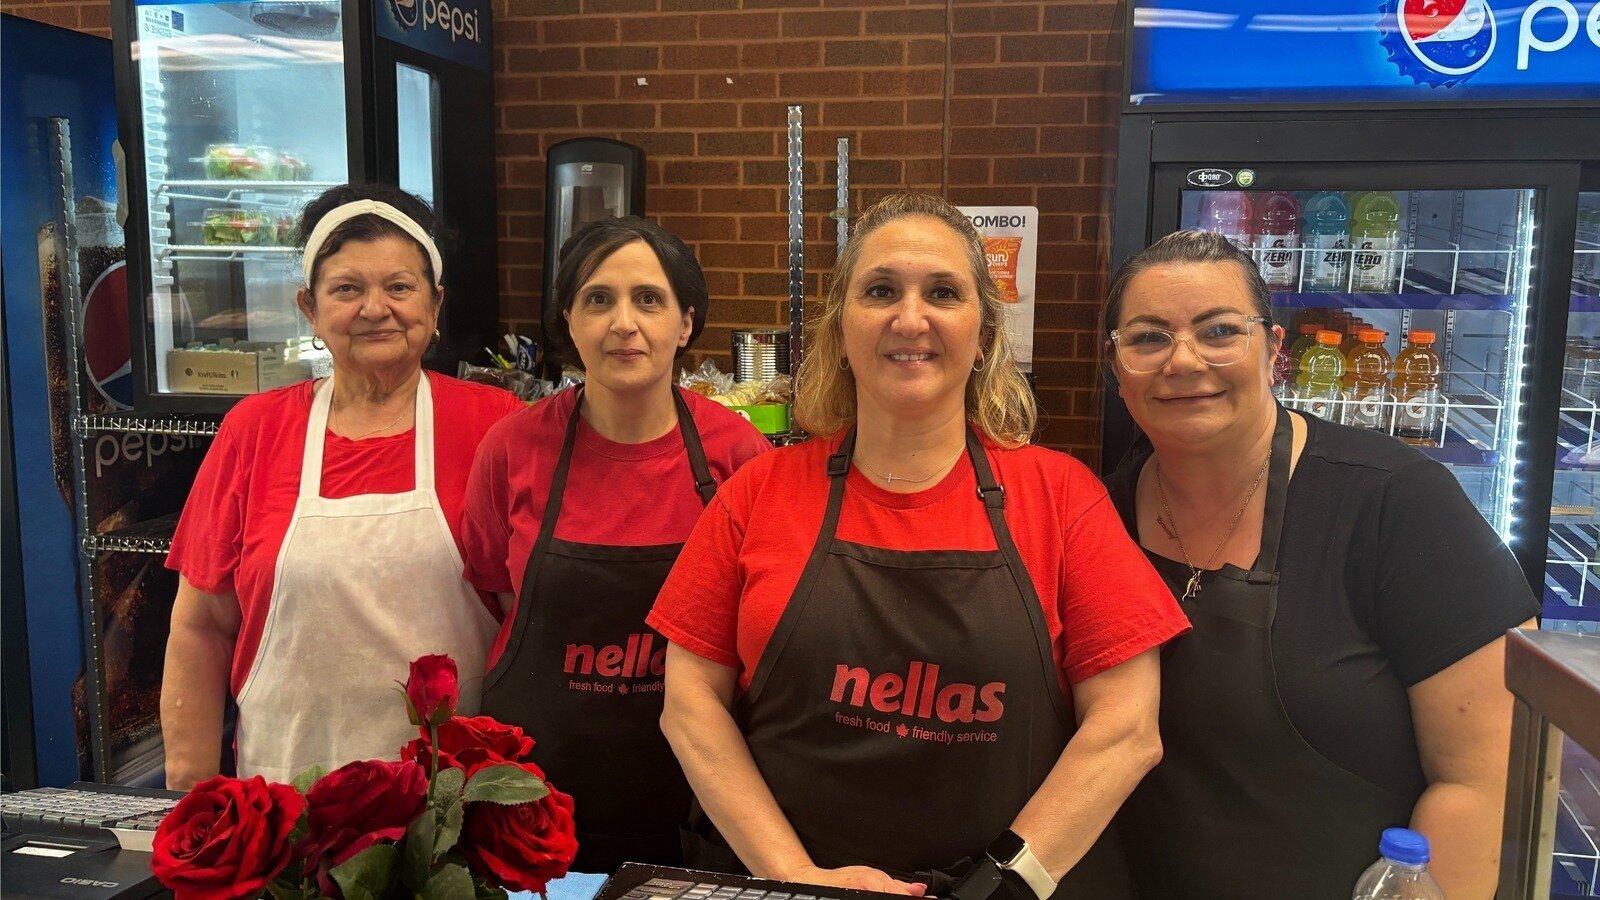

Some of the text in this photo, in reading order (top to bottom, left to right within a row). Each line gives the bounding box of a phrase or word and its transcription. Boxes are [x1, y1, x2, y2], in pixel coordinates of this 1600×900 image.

[422, 0, 479, 42] pepsi
[967, 215, 1026, 228] OMBO!
[568, 680, 592, 691] fresh
[593, 682, 614, 693] food
[829, 661, 1006, 724] nellas
[835, 711, 997, 746] fresh food friendly service
